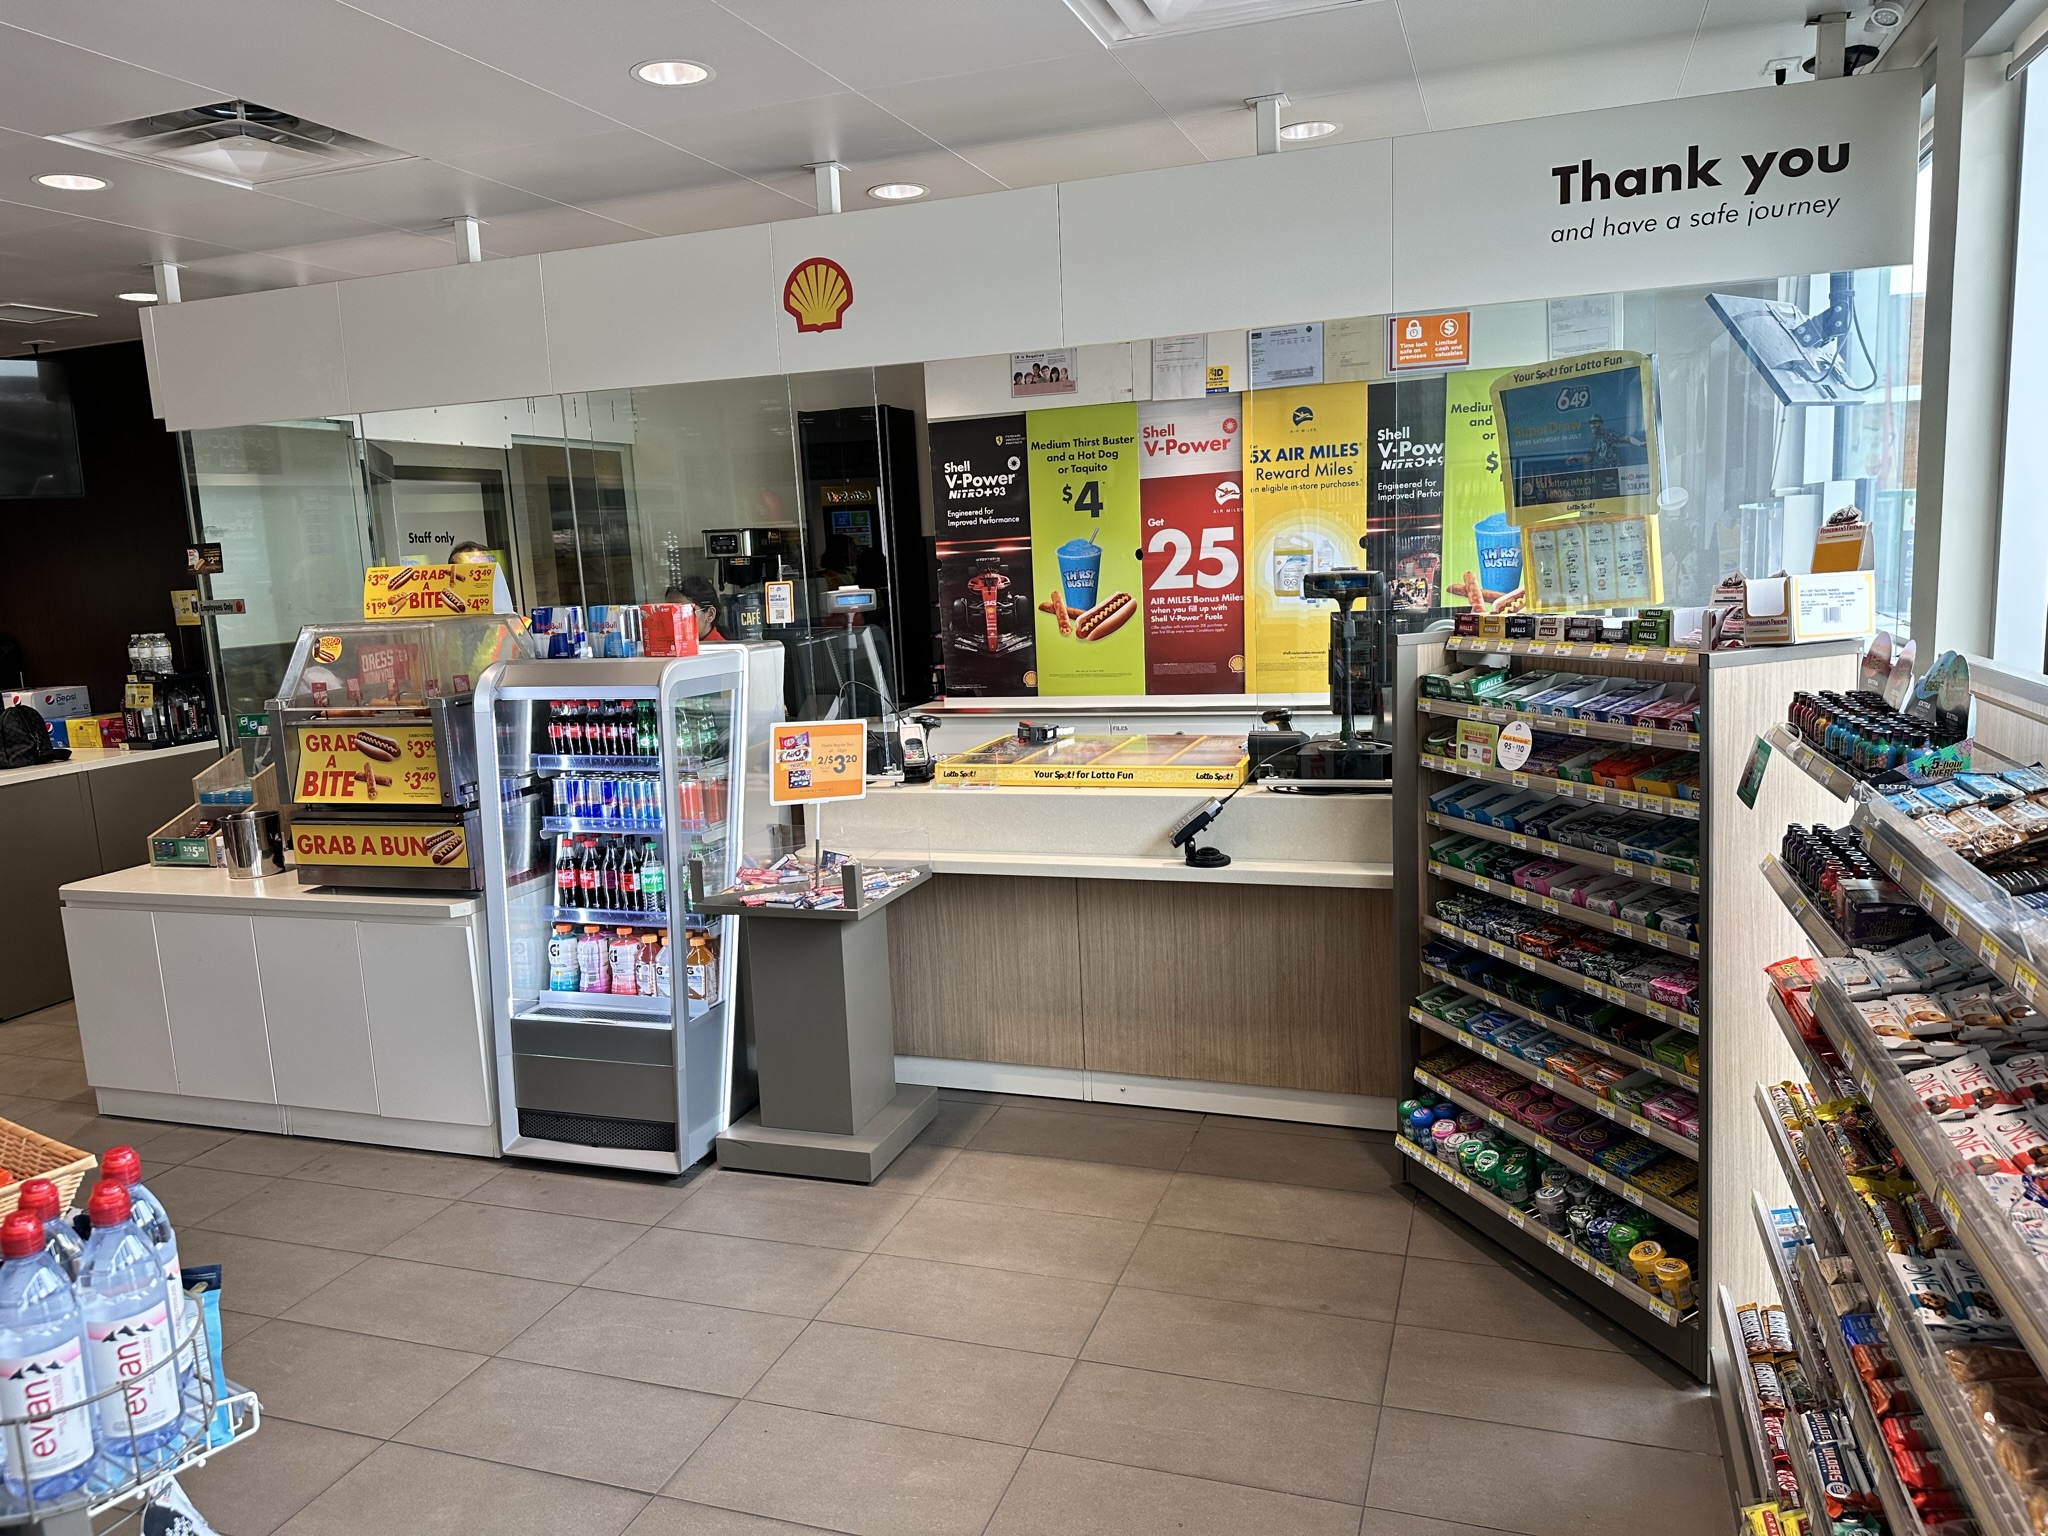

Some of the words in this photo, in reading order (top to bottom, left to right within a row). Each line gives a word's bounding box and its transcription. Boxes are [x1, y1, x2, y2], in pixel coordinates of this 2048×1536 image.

[1551, 144, 1722, 205] Thank
[1741, 142, 1850, 196] you
[1551, 218, 1595, 243] and
[1602, 214, 1657, 238] have
[1666, 216, 1680, 230] a
[1690, 202, 1739, 228] safe
[1747, 197, 1841, 226] journey
[1400, 353, 1427, 361] premises
[1434, 350, 1463, 358] valuables
[1513, 372, 1535, 383] Your
[1536, 367, 1558, 380] Spot!
[1559, 364, 1573, 375] for
[1575, 359, 1601, 372] Lotto
[1604, 356, 1623, 367] Fun
[1469, 415, 1493, 427] and
[1143, 423, 1175, 438] Shell
[1377, 426, 1410, 441] Shell
[1482, 432, 1496, 440] or
[1031, 440, 1070, 451] Medium
[1073, 437, 1100, 447] Thirst
[1102, 436, 1135, 445] Buster
[1144, 438, 1231, 457] V-Power
[1377, 440, 1445, 458] V-Pow
[1047, 452, 1065, 462] and
[1078, 451, 1096, 460] Hot
[1098, 450, 1119, 460] Dog
[1250, 449, 1271, 464] 5X
[1276, 447, 1305, 461] AIR
[1310, 443, 1359, 459] MILES
[944, 460, 971, 474] Shell
[1071, 462, 1108, 475] Taquito
[1256, 463, 1309, 480] Reward
[1315, 461, 1353, 477] Miles
[945, 473, 1016, 489] V-Power
[1261, 483, 1288, 494] eligible
[1291, 481, 1318, 491] in-store
[1377, 479, 1422, 492] Engineered
[1424, 478, 1437, 487] for
[1377, 491, 1415, 502] Improved
[1417, 489, 1442, 498] Perfor
[947, 507, 983, 519] Engineered
[984, 506, 994, 515] for
[947, 517, 977, 528] Improved
[979, 516, 1020, 525] Performance
[1148, 518, 1164, 527] Get
[1820, 526, 1847, 534] FISHERMAN'S
[408, 532, 432, 544] Staff
[435, 532, 455, 547] only
[1148, 526, 1239, 590] 25
[1481, 547, 1522, 560] THIRST
[1483, 557, 1520, 568] BUSTER
[411, 569, 446, 581] GRAB
[1063, 570, 1096, 581] THIRST
[423, 582, 430, 590] A
[1066, 577, 1095, 588] BUSTER
[410, 591, 443, 609] BITE
[1150, 597, 1165, 605] AIR
[1167, 595, 1192, 604] MILES
[1193, 595, 1219, 603] Bonus
[1221, 593, 1243, 602] Miles
[200, 603, 223, 612] Employees
[224, 603, 233, 612] Only
[1151, 606, 1171, 614] when
[741, 610, 761, 626] CAFÉ
[1151, 615, 1168, 623] Shell
[1169, 614, 1200, 622] V-Power
[551, 622, 563, 630] Bull
[605, 621, 617, 629] Bull
[361, 650, 393, 673] DRESS
[1480, 677, 1503, 690] HALLS
[305, 734, 357, 752] GRAB
[326, 755, 337, 768] A
[1930, 757, 1964, 770] 5-hour
[943, 770, 959, 778] Lotto
[1034, 770, 1053, 779] Your
[1055, 770, 1075, 780] Spot!
[1076, 770, 1090, 779] for
[1091, 771, 1116, 779] Lotto
[1118, 771, 1134, 779] Fun
[1196, 772, 1213, 780] Lotto
[1214, 772, 1233, 781] Spot!
[302, 770, 356, 797] BITE
[297, 834, 356, 855] GRAB
[361, 836, 377, 856] A
[381, 836, 428, 856] BUN
[1558, 959, 1578, 968] Dentyne
[1585, 968, 1607, 977] Dentyne
[1620, 981, 1642, 990] Dentyne
[1655, 992, 1679, 1003] Dentyne
[1658, 1100, 1682, 1113] Trident
[1649, 1114, 1669, 1127] Trident
[117, 1338, 147, 1418] evian
[24, 1378, 57, 1458] evian
[1812, 1410, 1833, 1440] BUILDE
[1822, 1447, 1843, 1482] UILDERS
[1765, 1510, 1778, 1536] CARA
